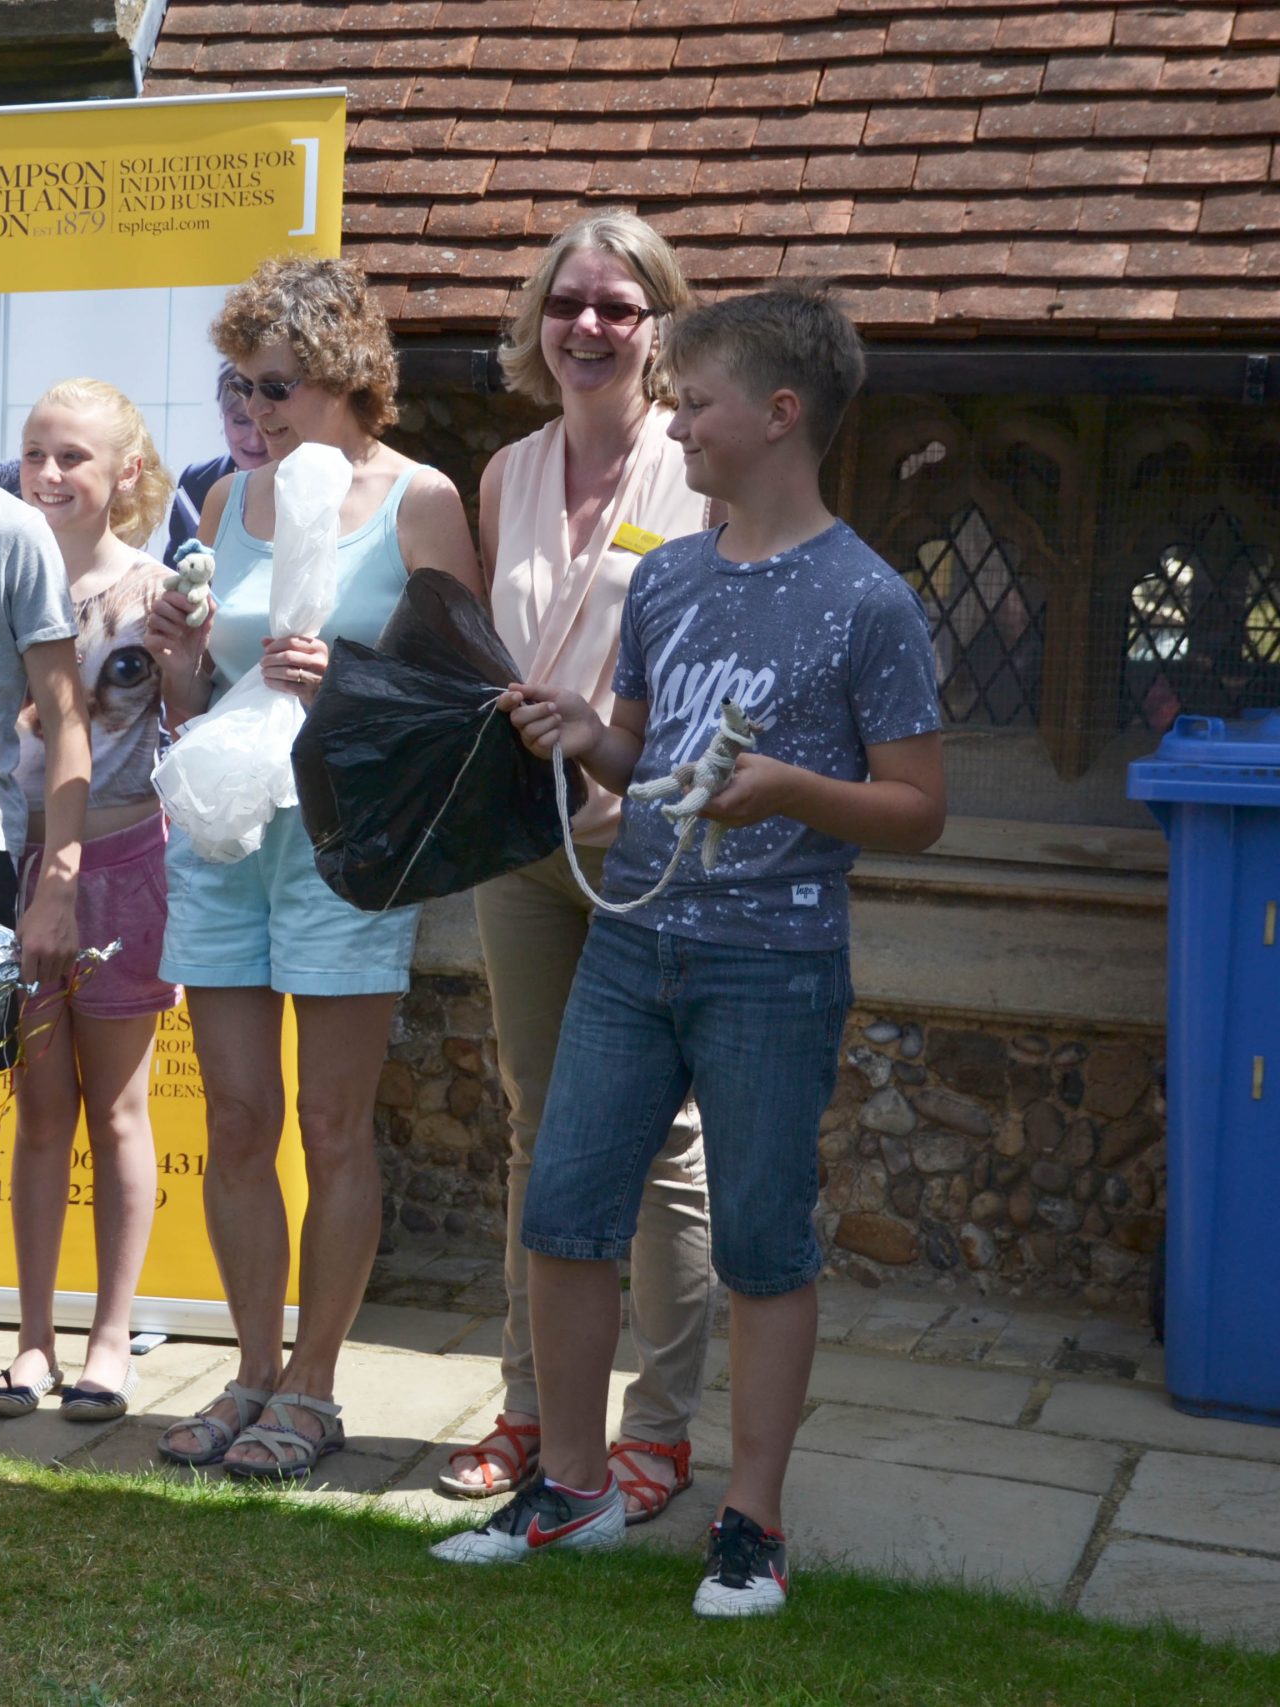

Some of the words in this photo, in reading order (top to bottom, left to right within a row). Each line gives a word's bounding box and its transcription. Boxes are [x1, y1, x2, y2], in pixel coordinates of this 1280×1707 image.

[119, 153, 248, 175] SOLICITORS
[254, 150, 297, 168] FOR
[120, 171, 261, 194] INDIVIDUALS
[33, 185, 107, 212] AND
[118, 194, 165, 212] AND
[171, 189, 275, 210] BUSINESS
[56, 211, 106, 236] 1879
[118, 217, 210, 236] tsplegal.com
[166, 1059, 201, 1075] DIS
[157, 1152, 206, 1175] 431
